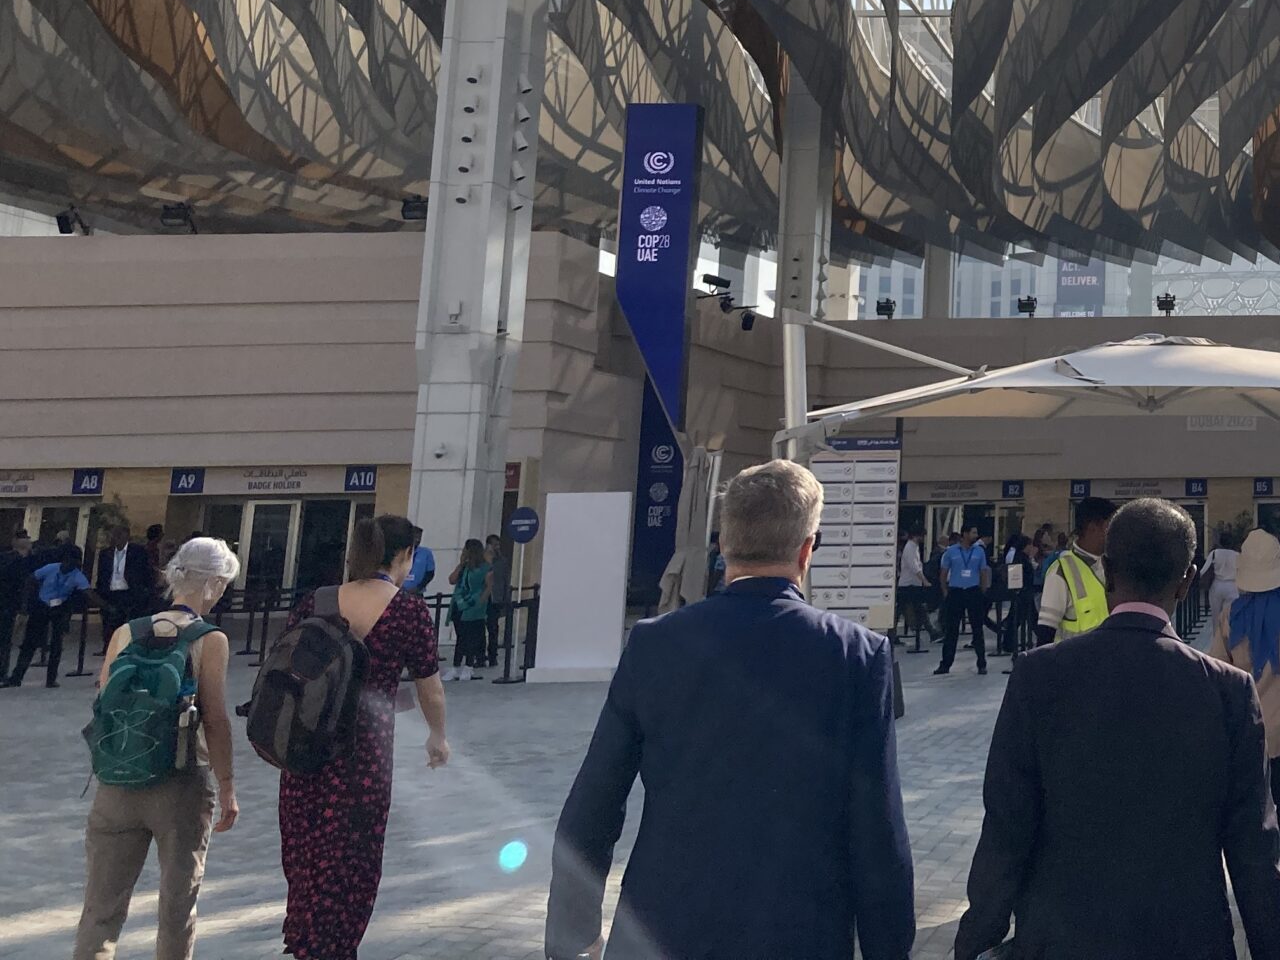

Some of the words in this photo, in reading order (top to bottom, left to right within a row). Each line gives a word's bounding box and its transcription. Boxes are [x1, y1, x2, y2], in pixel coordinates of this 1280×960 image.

[657, 186, 681, 195] Change
[638, 235, 670, 248] COP28
[637, 248, 658, 261] UAE
[1061, 275, 1100, 286] DELIVER.
[80, 475, 98, 489] A8
[178, 474, 195, 488] A9
[349, 471, 374, 486] A10
[247, 481, 272, 490] BADGE
[272, 480, 301, 490] HOLDER
[1008, 484, 1020, 495] B2
[1073, 484, 1085, 494] B3
[1191, 482, 1202, 492] B4
[1256, 482, 1268, 492] B5
